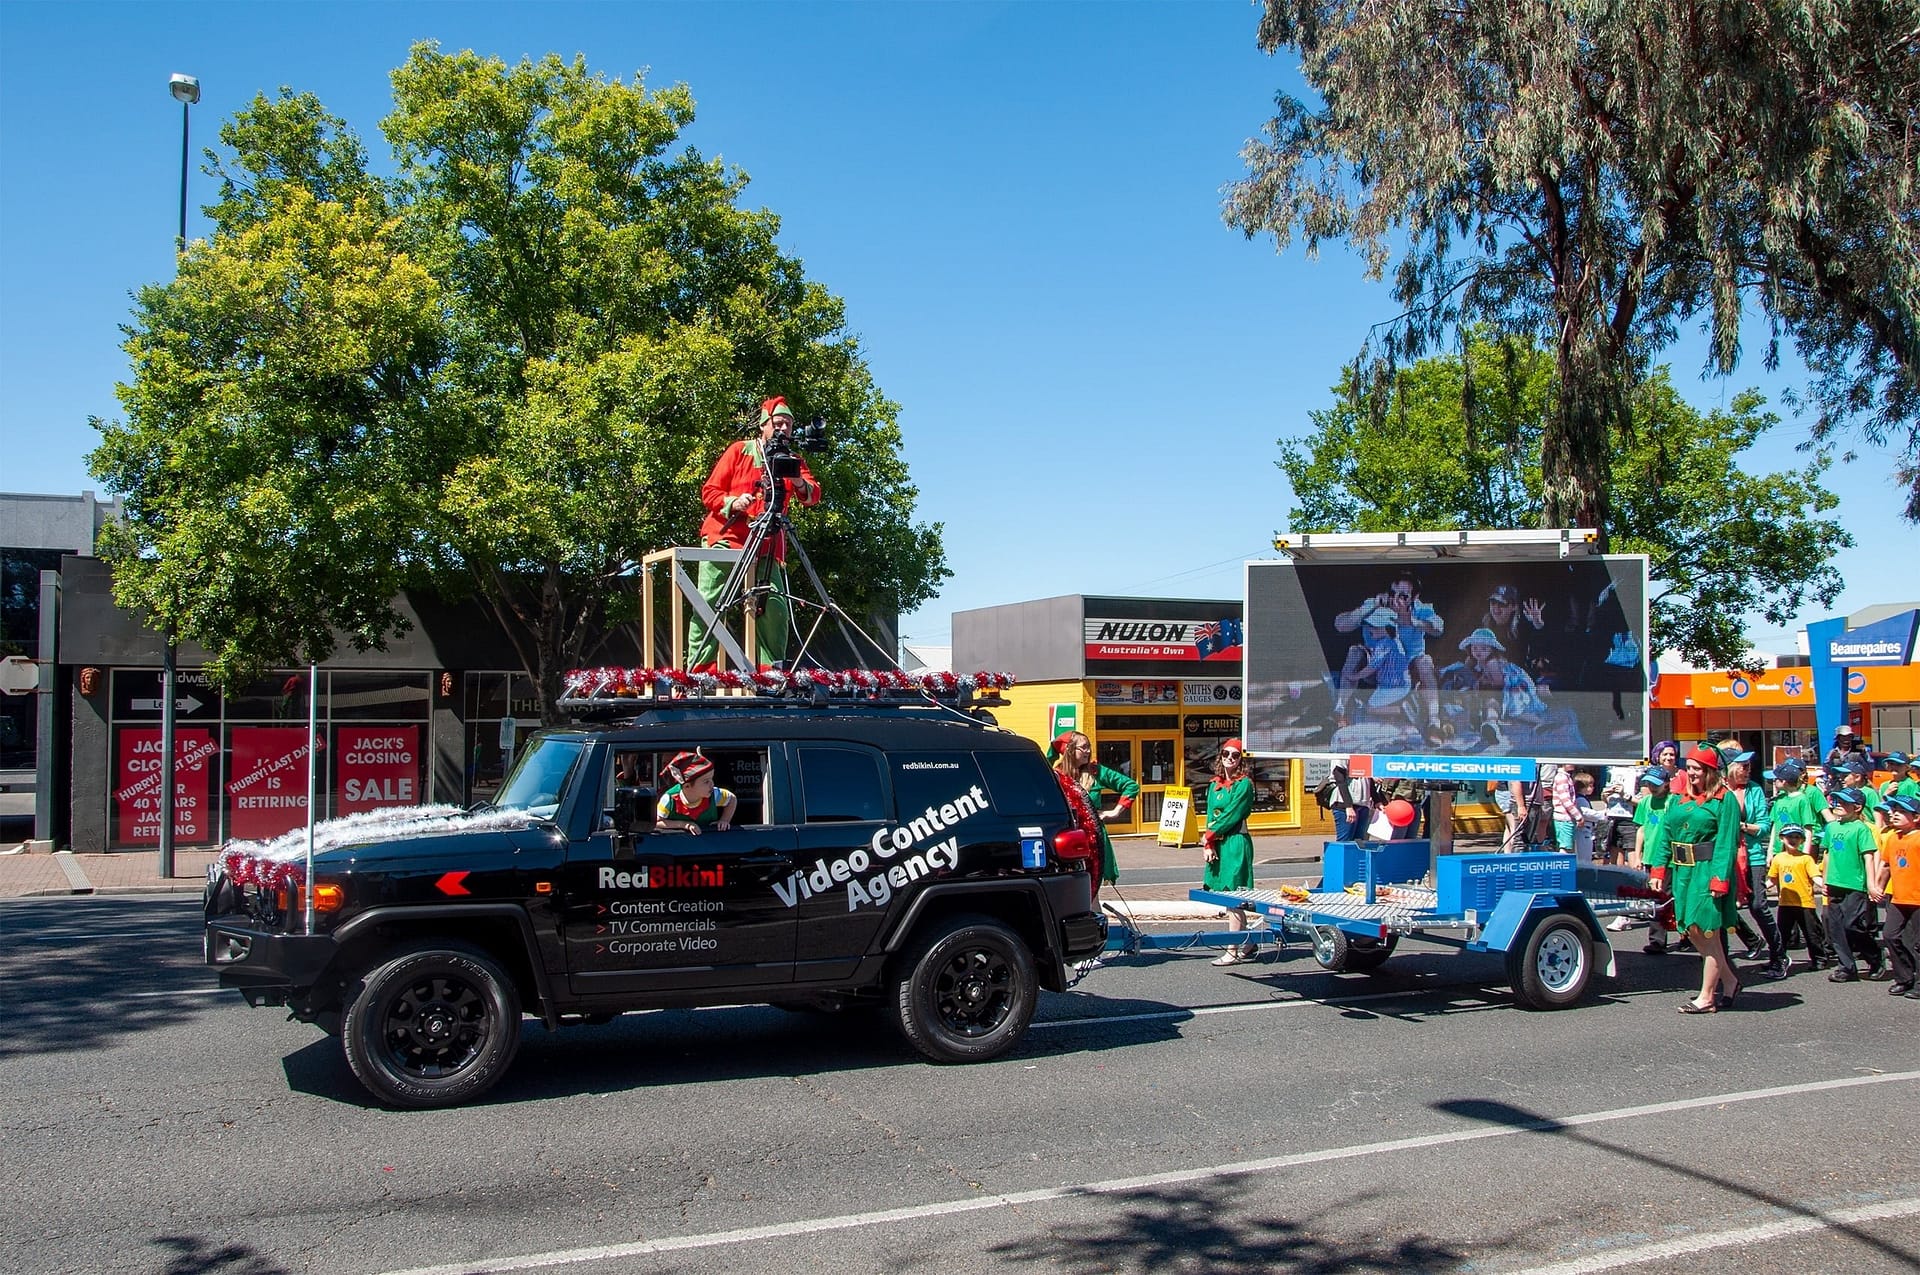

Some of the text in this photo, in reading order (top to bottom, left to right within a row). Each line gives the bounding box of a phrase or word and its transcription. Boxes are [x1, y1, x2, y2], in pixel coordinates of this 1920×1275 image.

[1096, 622, 1188, 641] NULON
[1099, 646, 1185, 655] Australia's Own
[1830, 640, 1901, 657] Beaurepaires
[1183, 684, 1212, 695] SMITHS
[512, 699, 541, 712] THE
[1183, 695, 1212, 703] GAUGES
[1203, 719, 1240, 729] PENRITE
[133, 740, 177, 754] JAC
[353, 737, 404, 750] JACK'S
[345, 752, 412, 765] CLOSING
[118, 774, 160, 801] HURRY!
[184, 741, 216, 764] DAYS!
[902, 761, 959, 770] redbikini.com.au
[1451, 763, 1486, 774] SIGN
[1487, 764, 1521, 774] HIRE
[229, 768, 269, 793] HURRY!
[268, 754, 293, 773] LAST
[267, 777, 281, 789] IS
[345, 778, 412, 802] SALE
[133, 798, 150, 809] 40
[238, 795, 308, 809] RETIRING
[1167, 801, 1183, 809] OPEN
[180, 811, 193, 822] IS
[1171, 810, 1177, 818] 7
[1164, 819, 1180, 828] DAYS
[771, 784, 989, 908] Video Content
[1518, 861, 1545, 872] SIGN
[1545, 861, 1570, 871] HIRE
[598, 864, 724, 889] RedBikini
[846, 836, 959, 912] Agency
[610, 900, 724, 914] Content Creation
[609, 918, 716, 934] TV Commercials
[609, 937, 718, 955] Corporate Video
